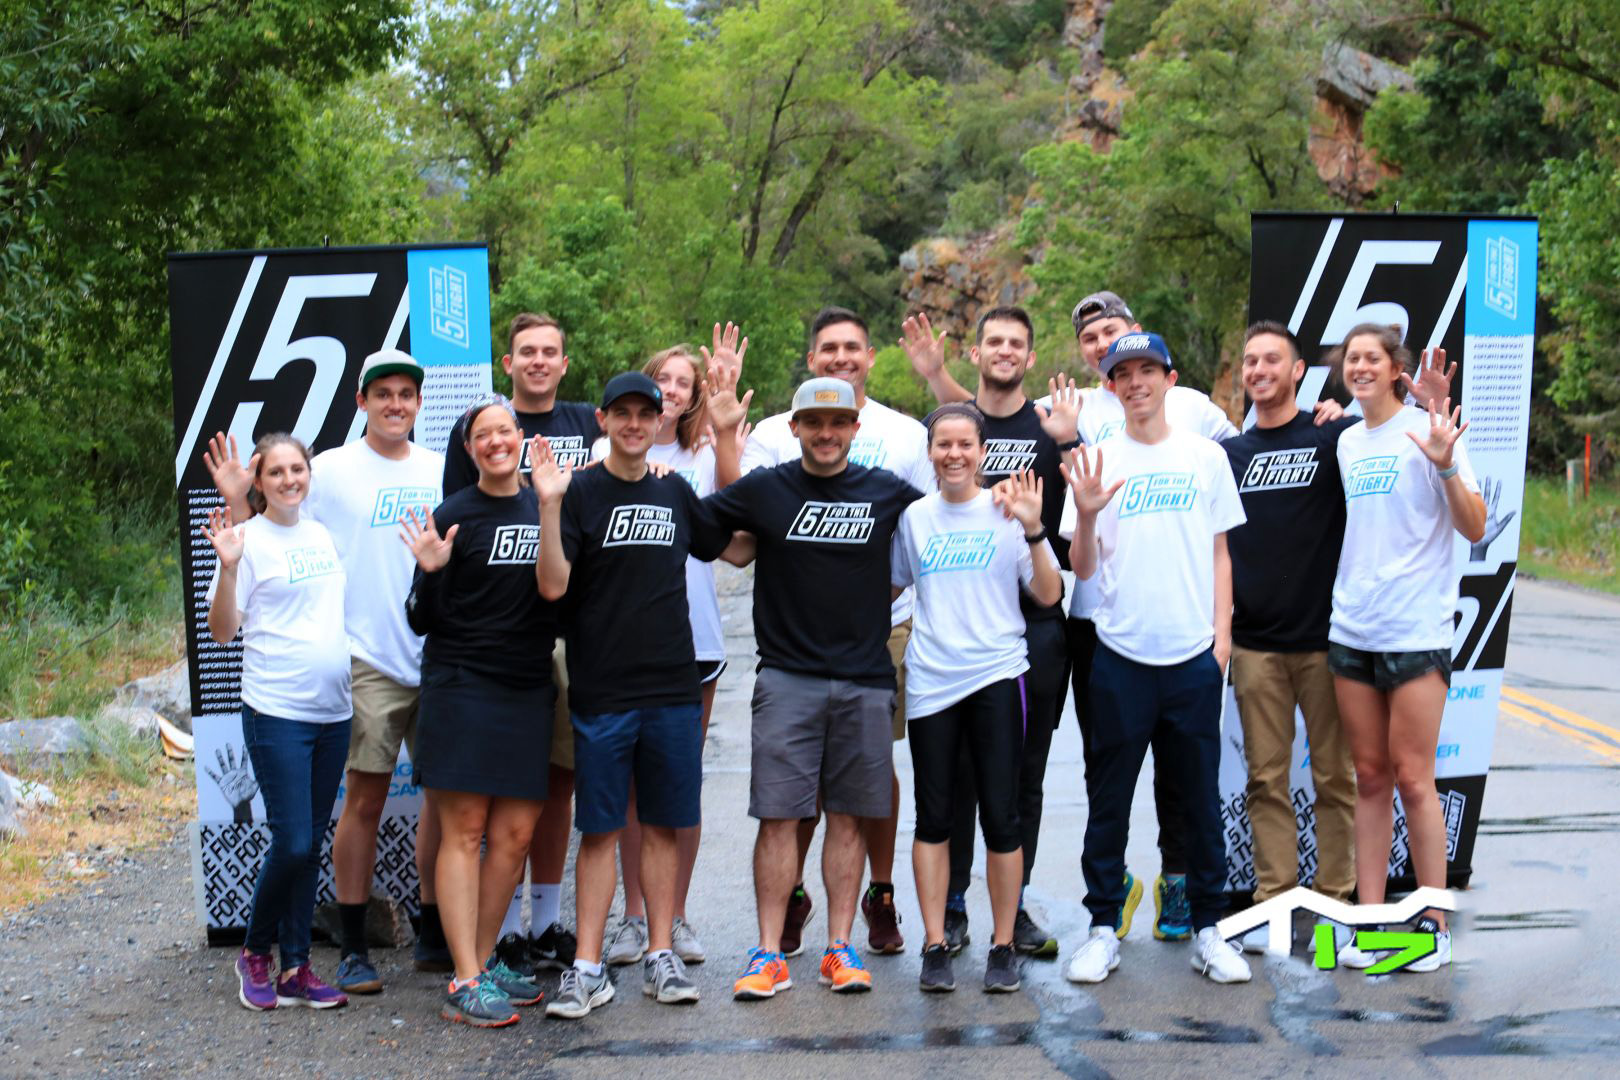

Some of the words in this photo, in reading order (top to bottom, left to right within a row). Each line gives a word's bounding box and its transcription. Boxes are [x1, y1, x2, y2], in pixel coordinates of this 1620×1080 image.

[450, 272, 464, 318] FIGHT
[1489, 287, 1514, 312] 5
[436, 315, 464, 339] 5
[564, 440, 579, 448] THE
[1012, 443, 1030, 452] THE
[553, 452, 584, 467] IGHT
[984, 456, 1031, 470] FIGHT
[1247, 459, 1268, 486] 5
[1266, 466, 1312, 486] FIGHT
[1355, 476, 1392, 492] FIGHT
[1126, 481, 1144, 510] 5
[1146, 493, 1190, 508] FIGHT
[380, 493, 396, 520] 5
[612, 511, 632, 540] 5
[639, 508, 654, 520] FOR
[655, 510, 670, 522] THE
[797, 507, 822, 535] 5
[829, 507, 848, 518] FOR
[850, 507, 866, 518] THE
[820, 522, 870, 539] FIGHT
[633, 524, 672, 541] FIGHT
[499, 530, 516, 559] 5
[922, 539, 944, 569] 5
[291, 554, 304, 574] 5
[942, 550, 986, 566] FIGHT
[1228, 828, 1240, 846] 5
[224, 858, 240, 878] 5
[234, 830, 270, 868] FOR
[386, 880, 402, 898] 5
[210, 888, 244, 928] FOR
